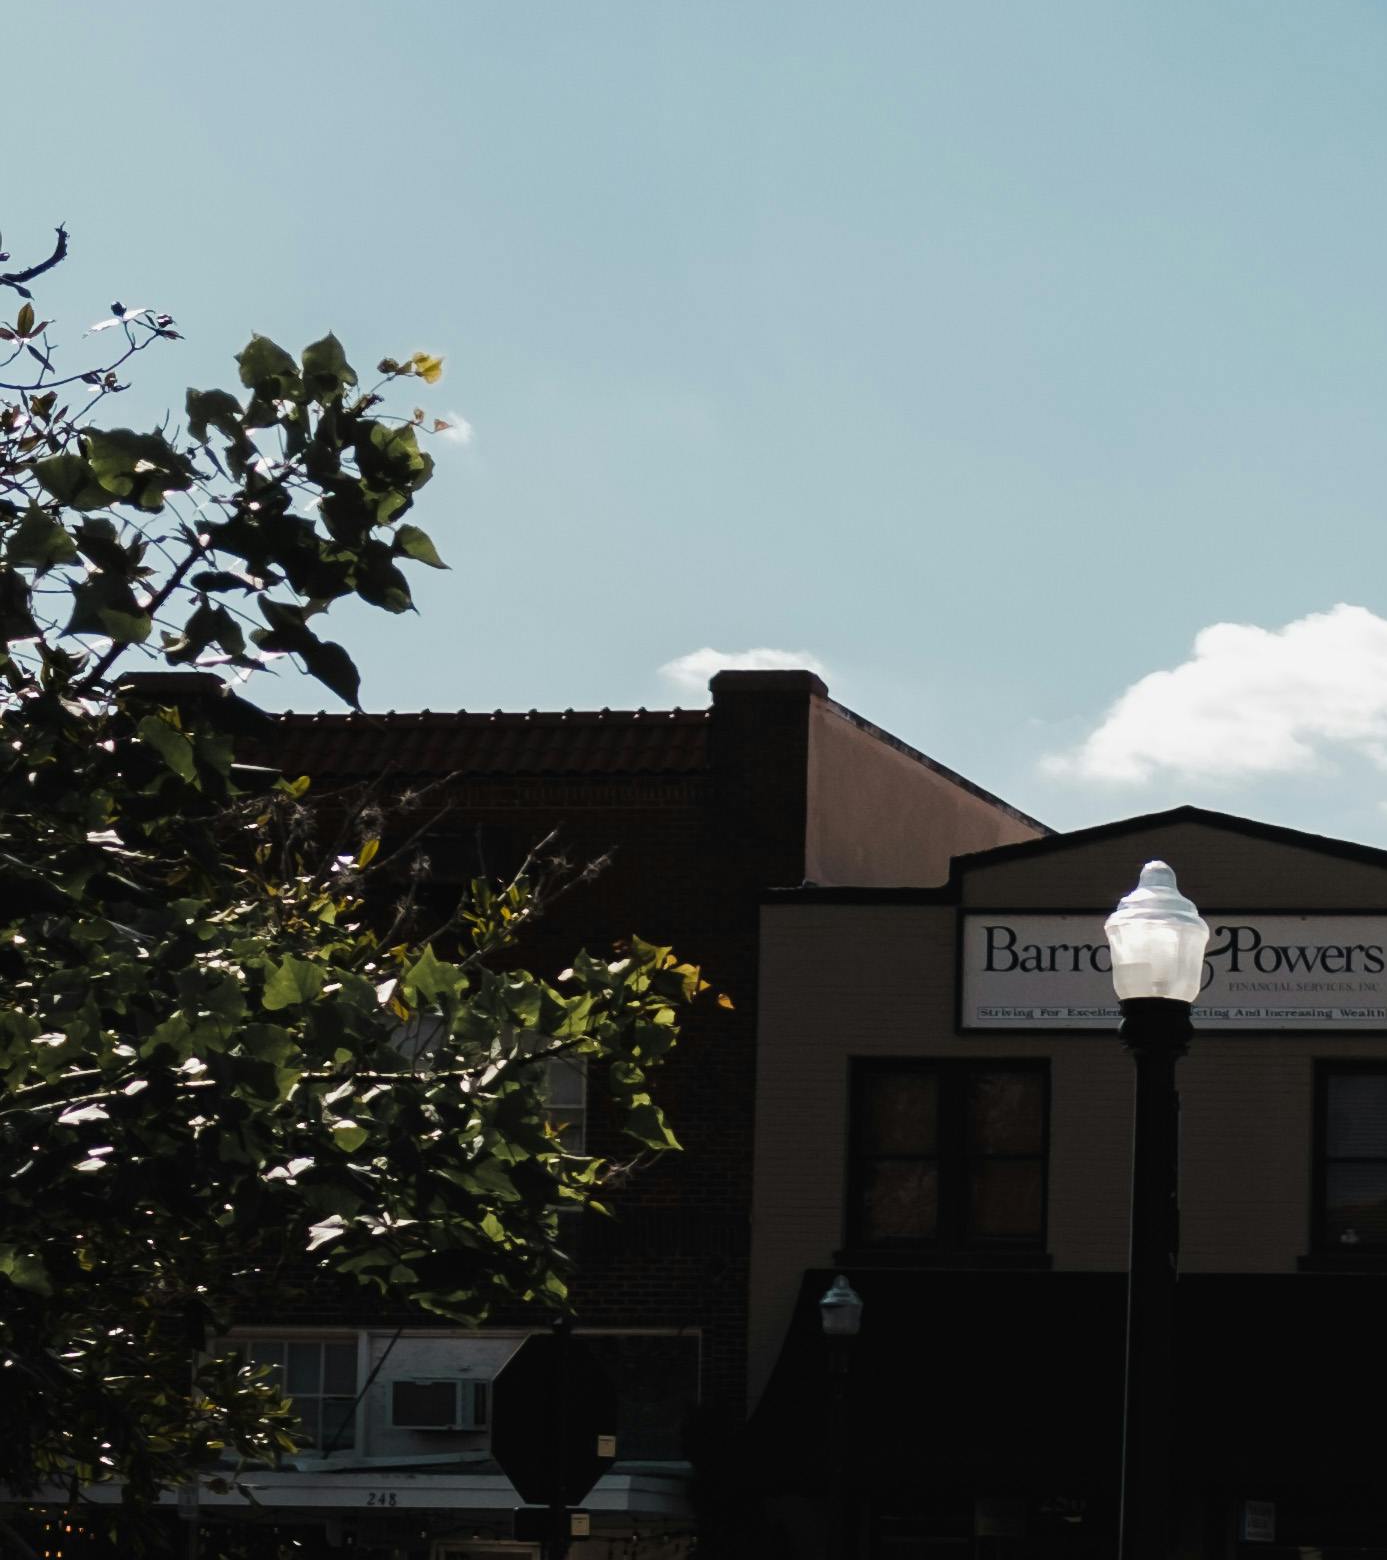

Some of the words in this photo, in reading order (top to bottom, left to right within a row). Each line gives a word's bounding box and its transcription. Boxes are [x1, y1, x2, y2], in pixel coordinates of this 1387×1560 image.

[983, 925, 1113, 973] Barro
[1214, 925, 1385, 974] Powers
[1229, 982, 1293, 992] FINANCIAL
[980, 1007, 1033, 1019] Striving
[1041, 1007, 1060, 1017] For
[1068, 1007, 1121, 1017] Excellen
[1235, 1008, 1260, 1017] And
[1265, 1007, 1332, 1019] Increasing
[1340, 1008, 1385, 1017] Wealth
